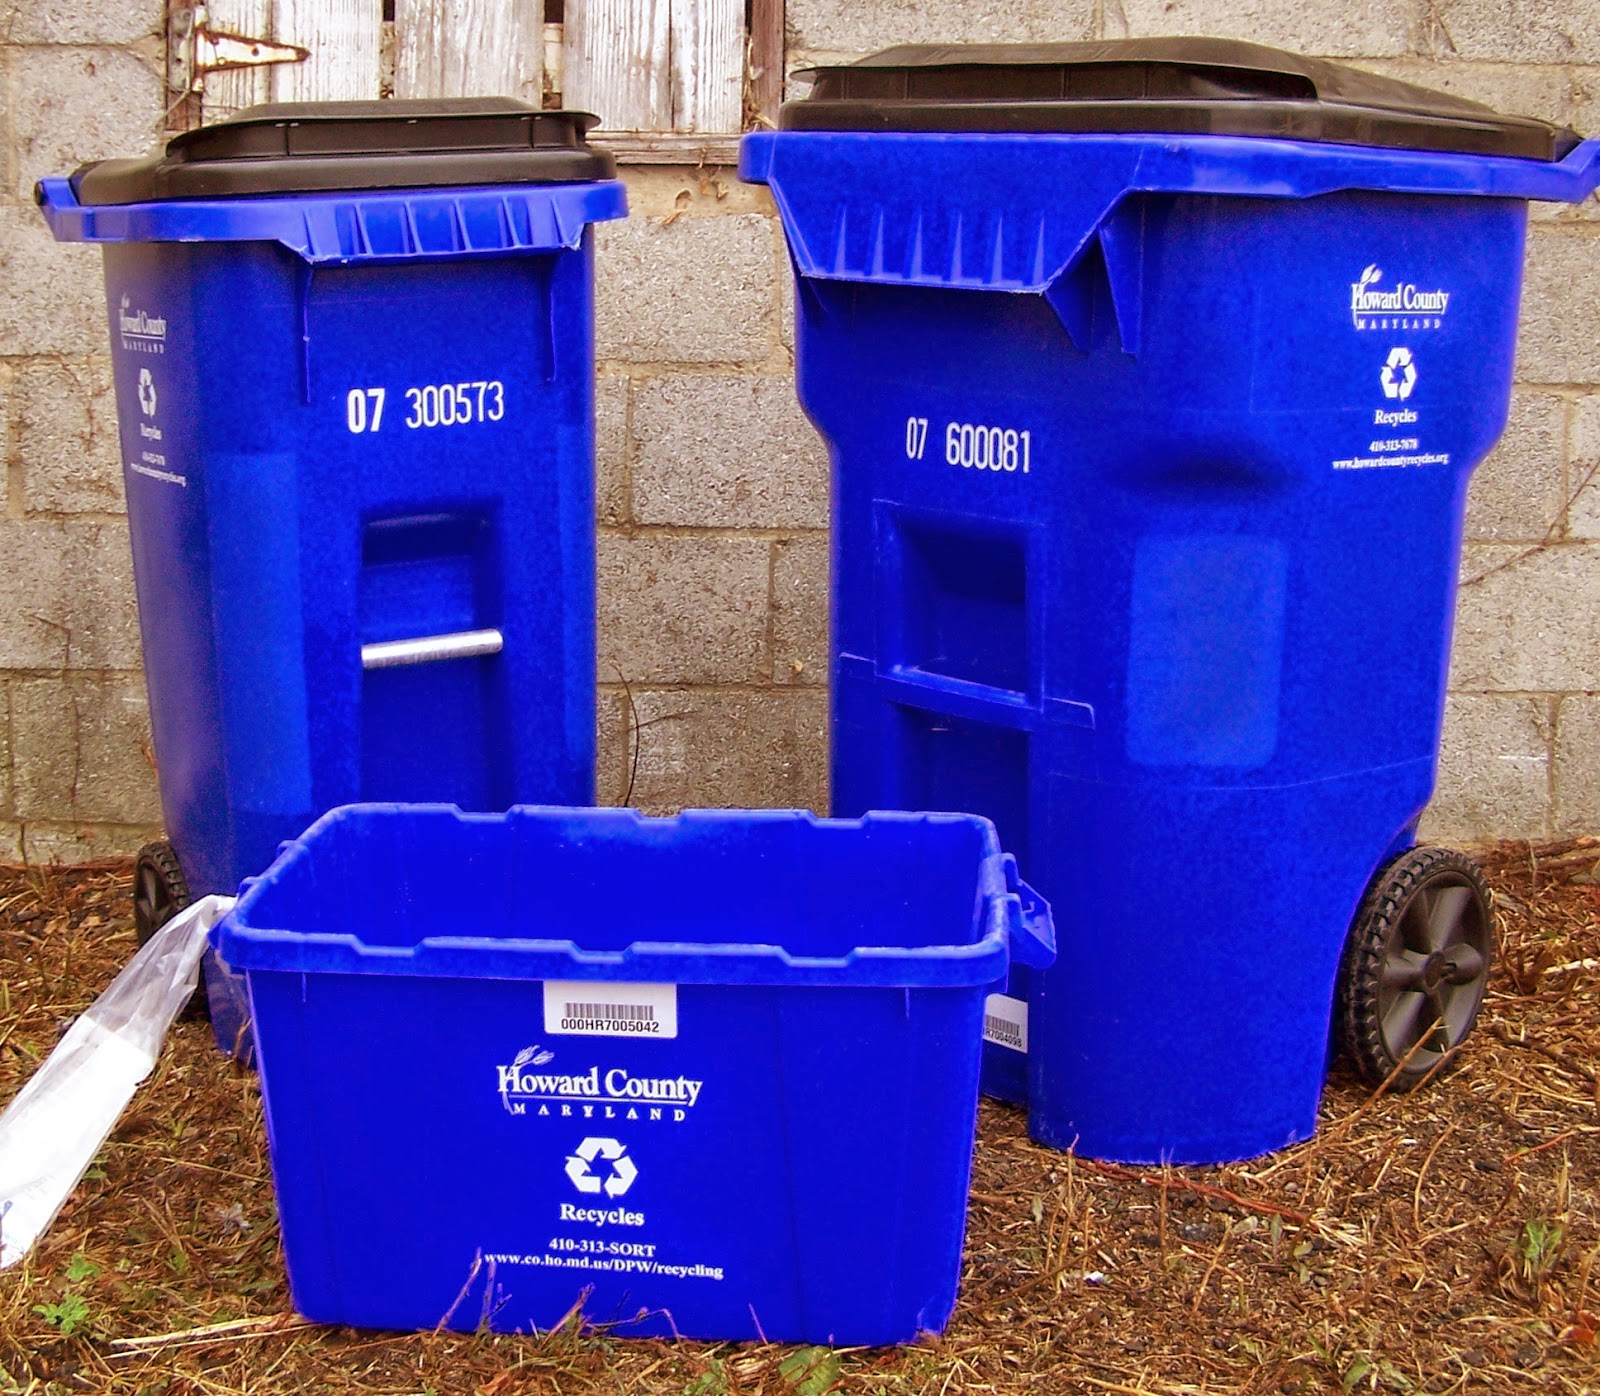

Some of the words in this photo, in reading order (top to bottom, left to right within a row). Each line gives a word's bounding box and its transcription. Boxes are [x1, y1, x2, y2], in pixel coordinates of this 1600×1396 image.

[1351, 282, 1401, 311] Howard
[1403, 284, 1449, 315] County
[1356, 318, 1441, 330] MARYLAND
[347, 387, 386, 434] 07
[404, 380, 505, 430] 300573
[1374, 409, 1417, 427] Recycles
[905, 416, 929, 461] 07
[945, 421, 1031, 474] 600081
[1332, 453, 1449, 470] www.howardcountyrecycles.org
[560, 1017, 660, 1034] 000HR7005042
[496, 1065, 600, 1096] Howard
[604, 1067, 703, 1107] County
[513, 1103, 686, 1122] MARYLAND
[559, 1203, 645, 1227] Recycles
[548, 1237, 656, 1258] 410-313-SORT
[483, 1252, 724, 1280] www.co.ho.md.us/DPW/recycling
